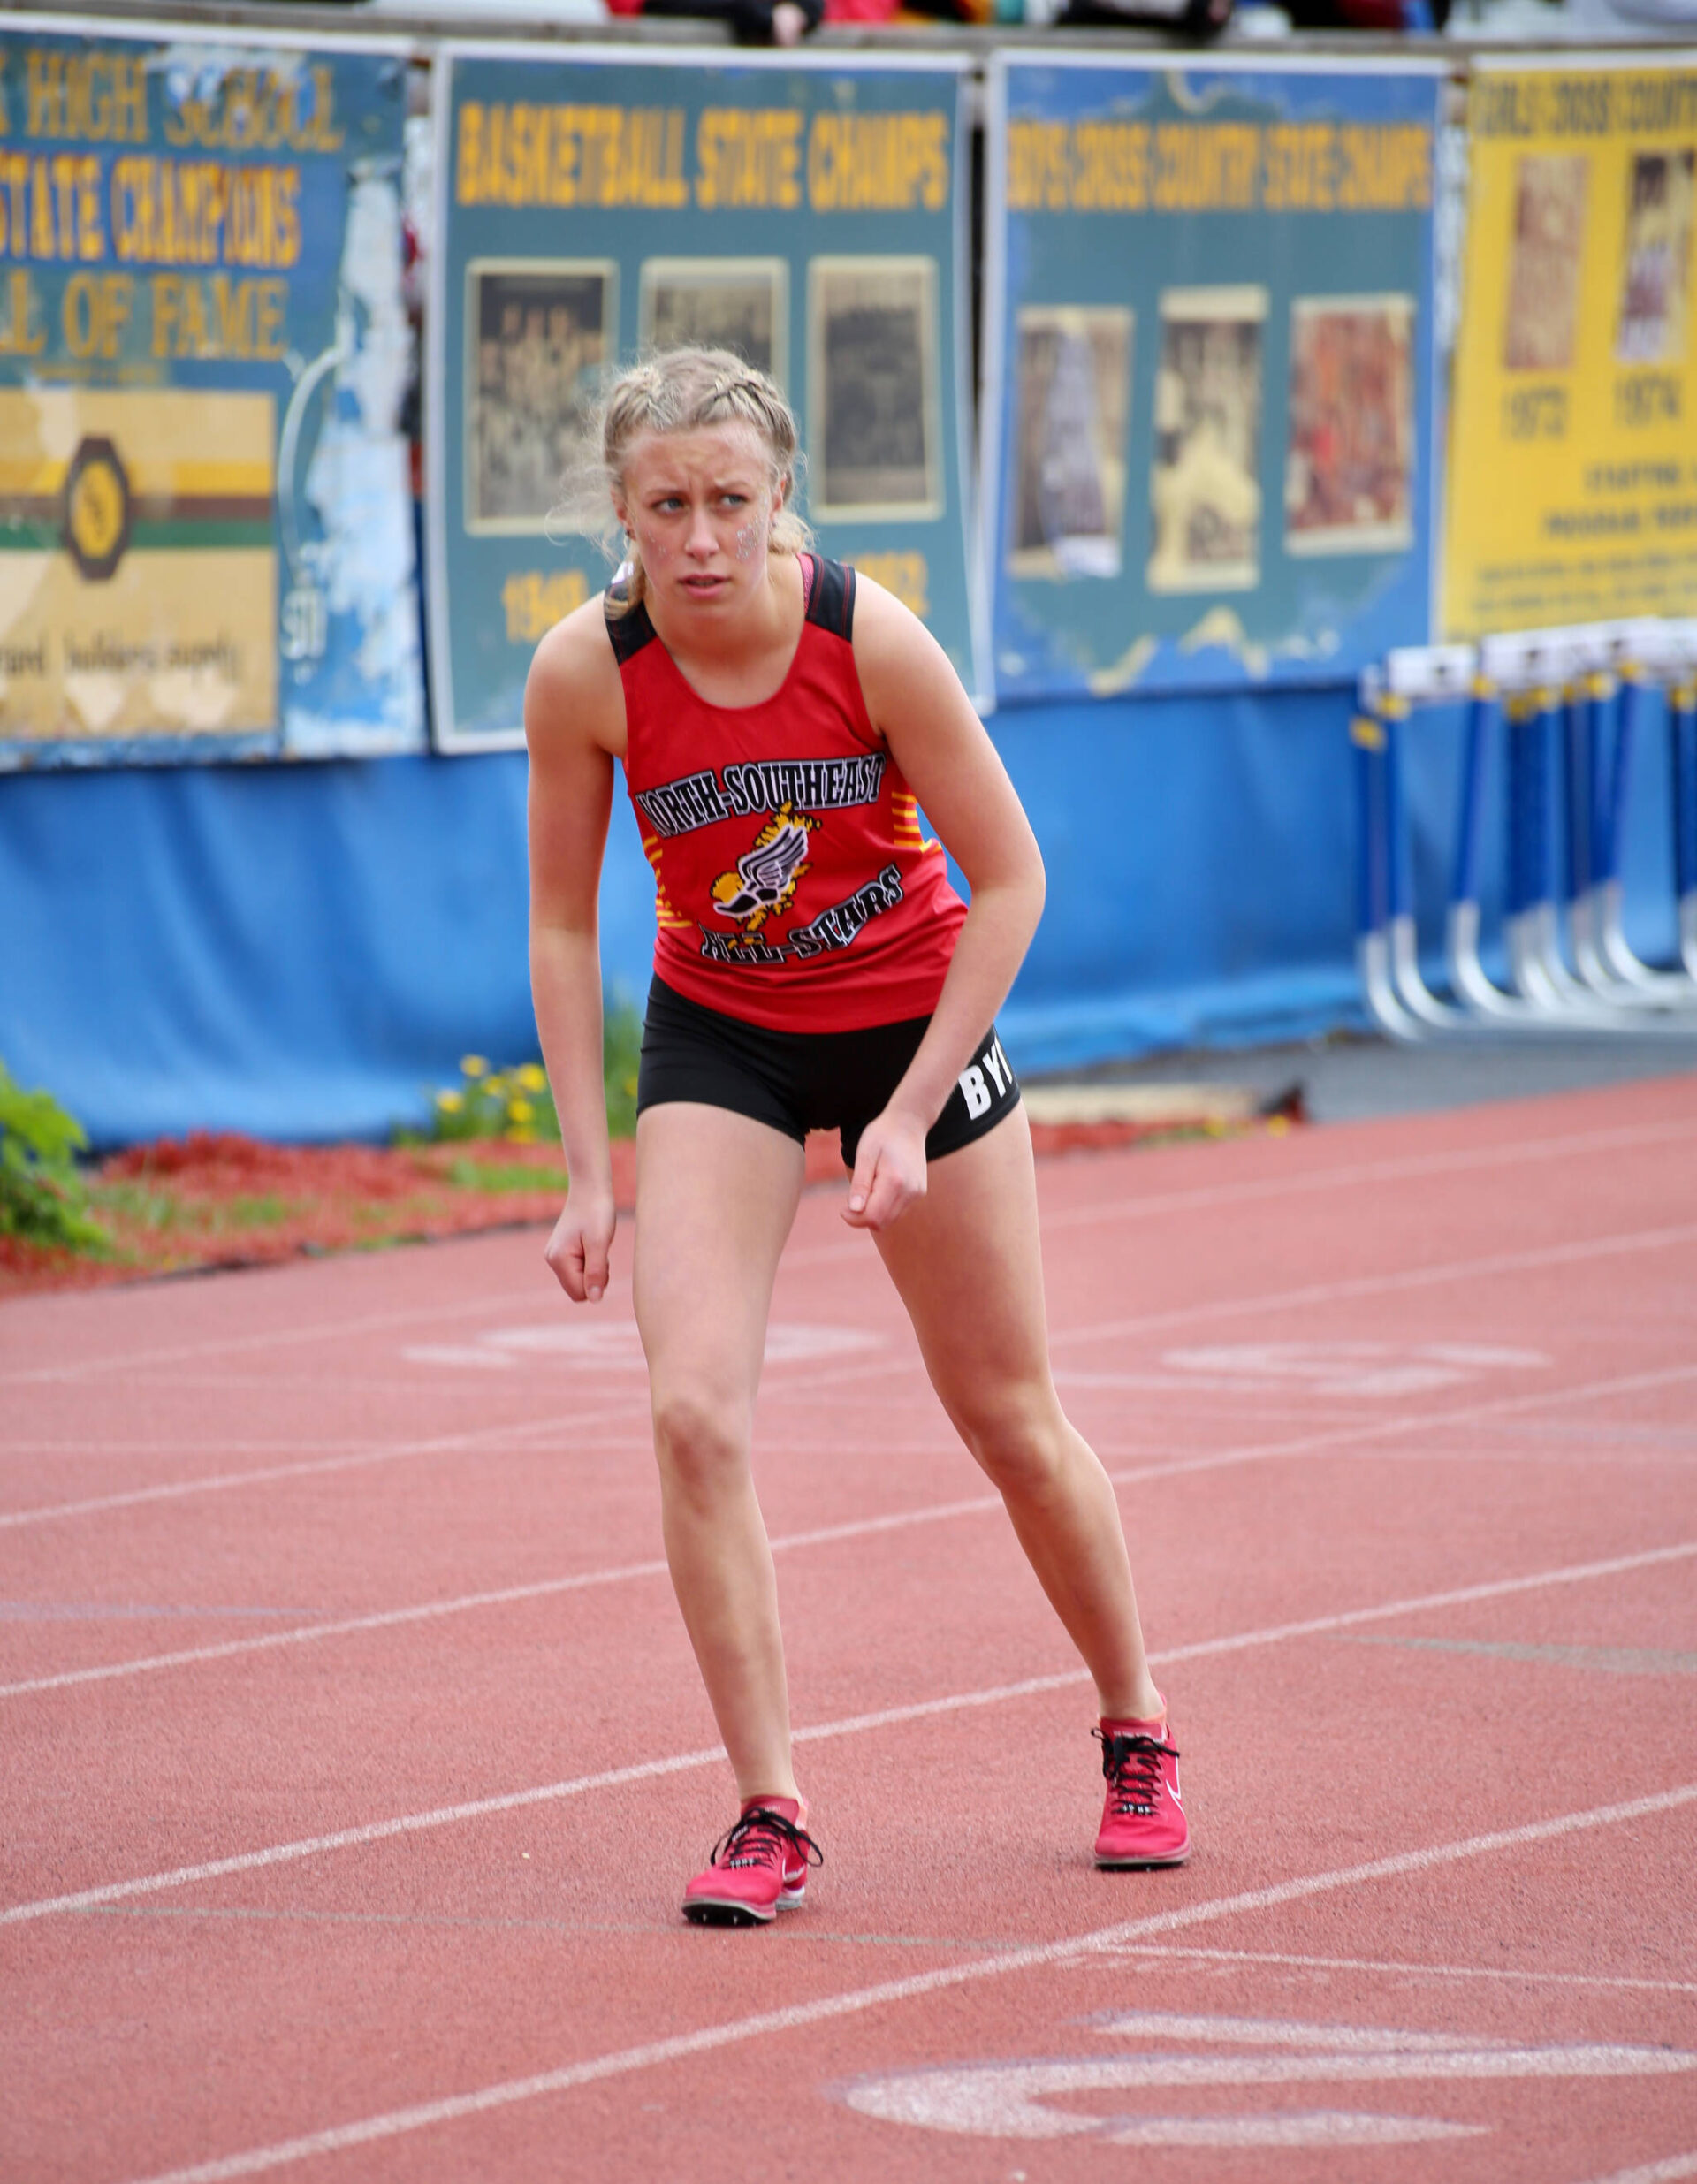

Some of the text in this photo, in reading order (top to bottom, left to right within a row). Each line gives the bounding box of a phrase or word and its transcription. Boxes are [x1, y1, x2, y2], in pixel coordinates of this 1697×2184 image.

[27, 50, 147, 142] HIGH
[457, 102, 949, 212] BASKETBALL STATE CHAMPS
[62, 271, 134, 358] OF
[150, 271, 290, 361] FAME
